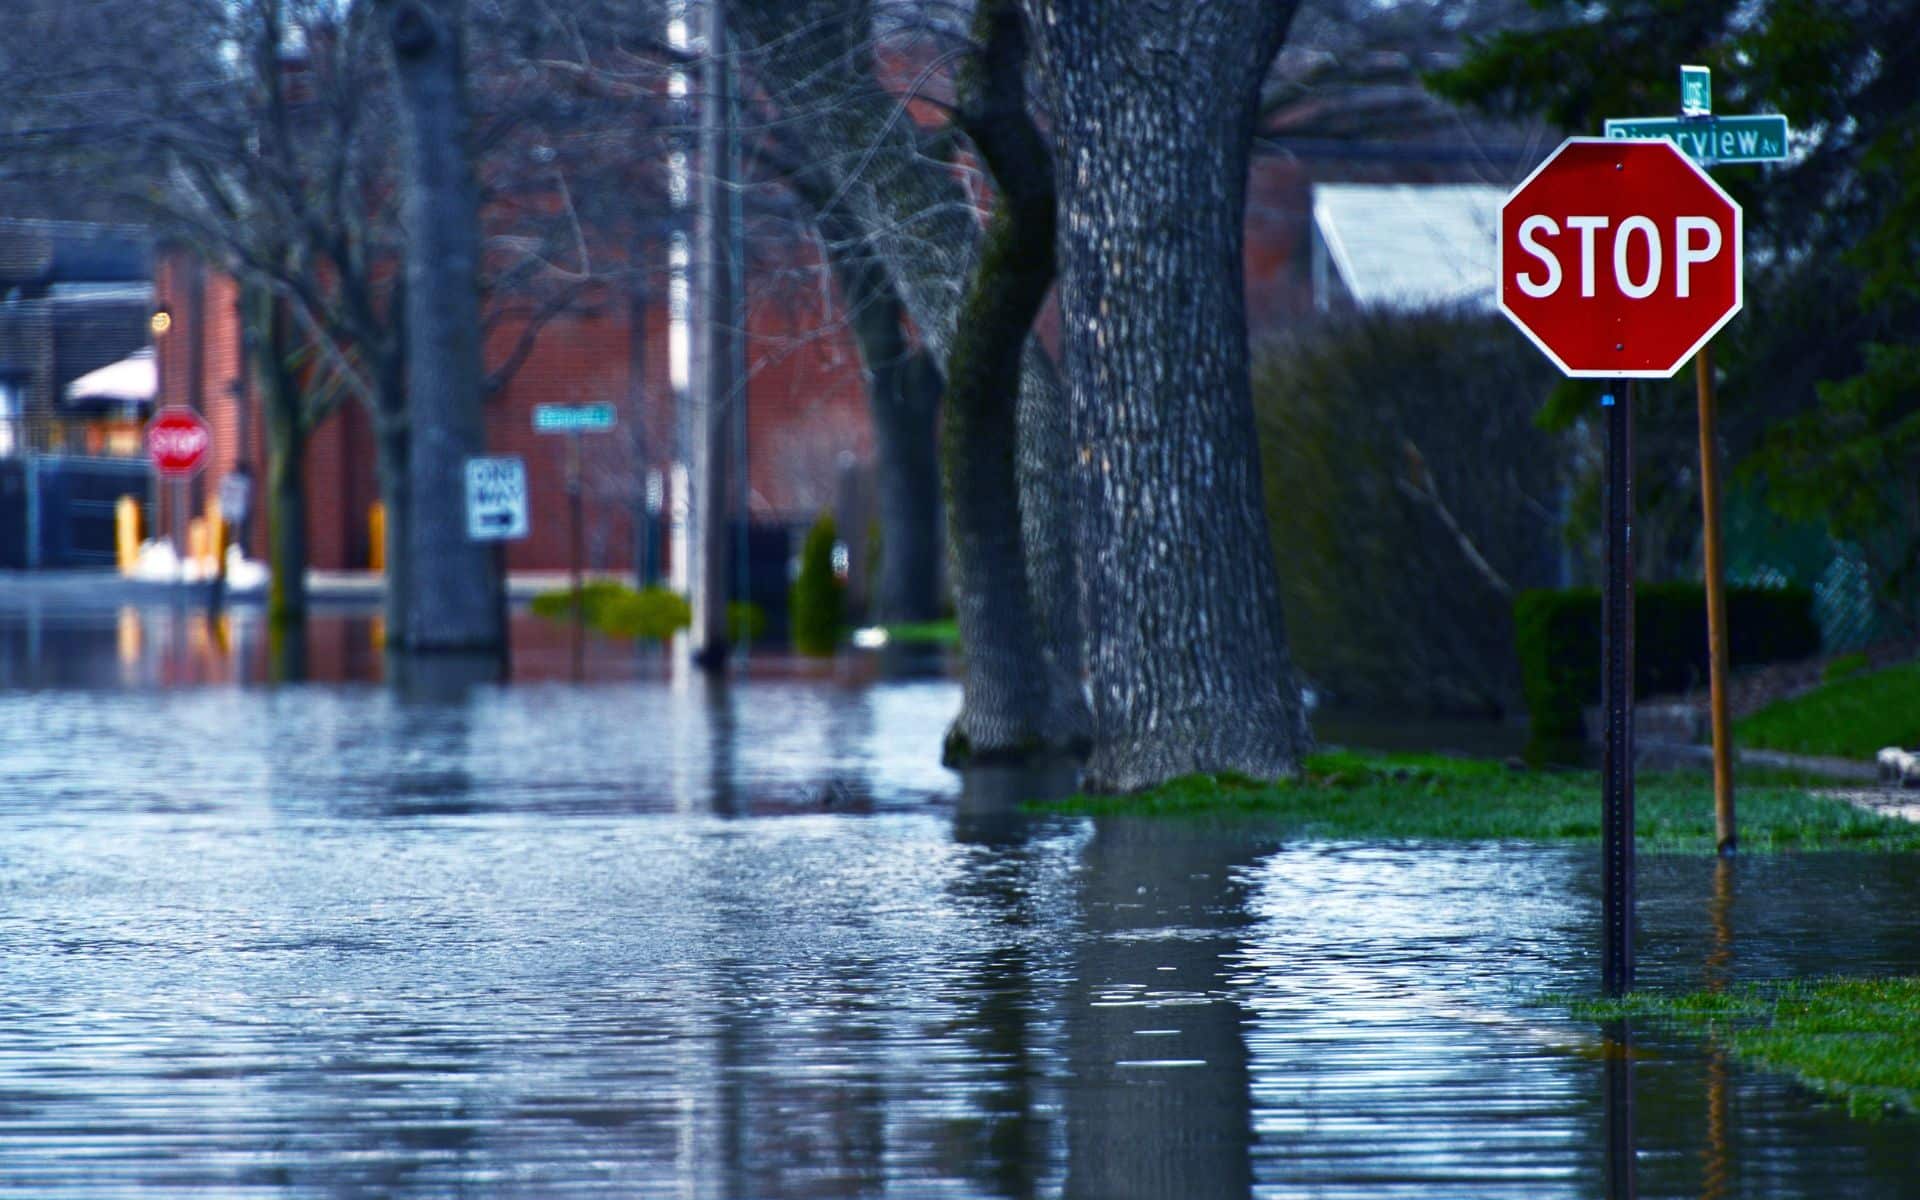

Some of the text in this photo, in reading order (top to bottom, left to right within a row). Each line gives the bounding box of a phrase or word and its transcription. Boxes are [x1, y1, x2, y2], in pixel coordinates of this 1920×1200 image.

[1611, 124, 1759, 159] rview
[1516, 214, 1722, 299] STOP
[150, 427, 208, 456] STOP
